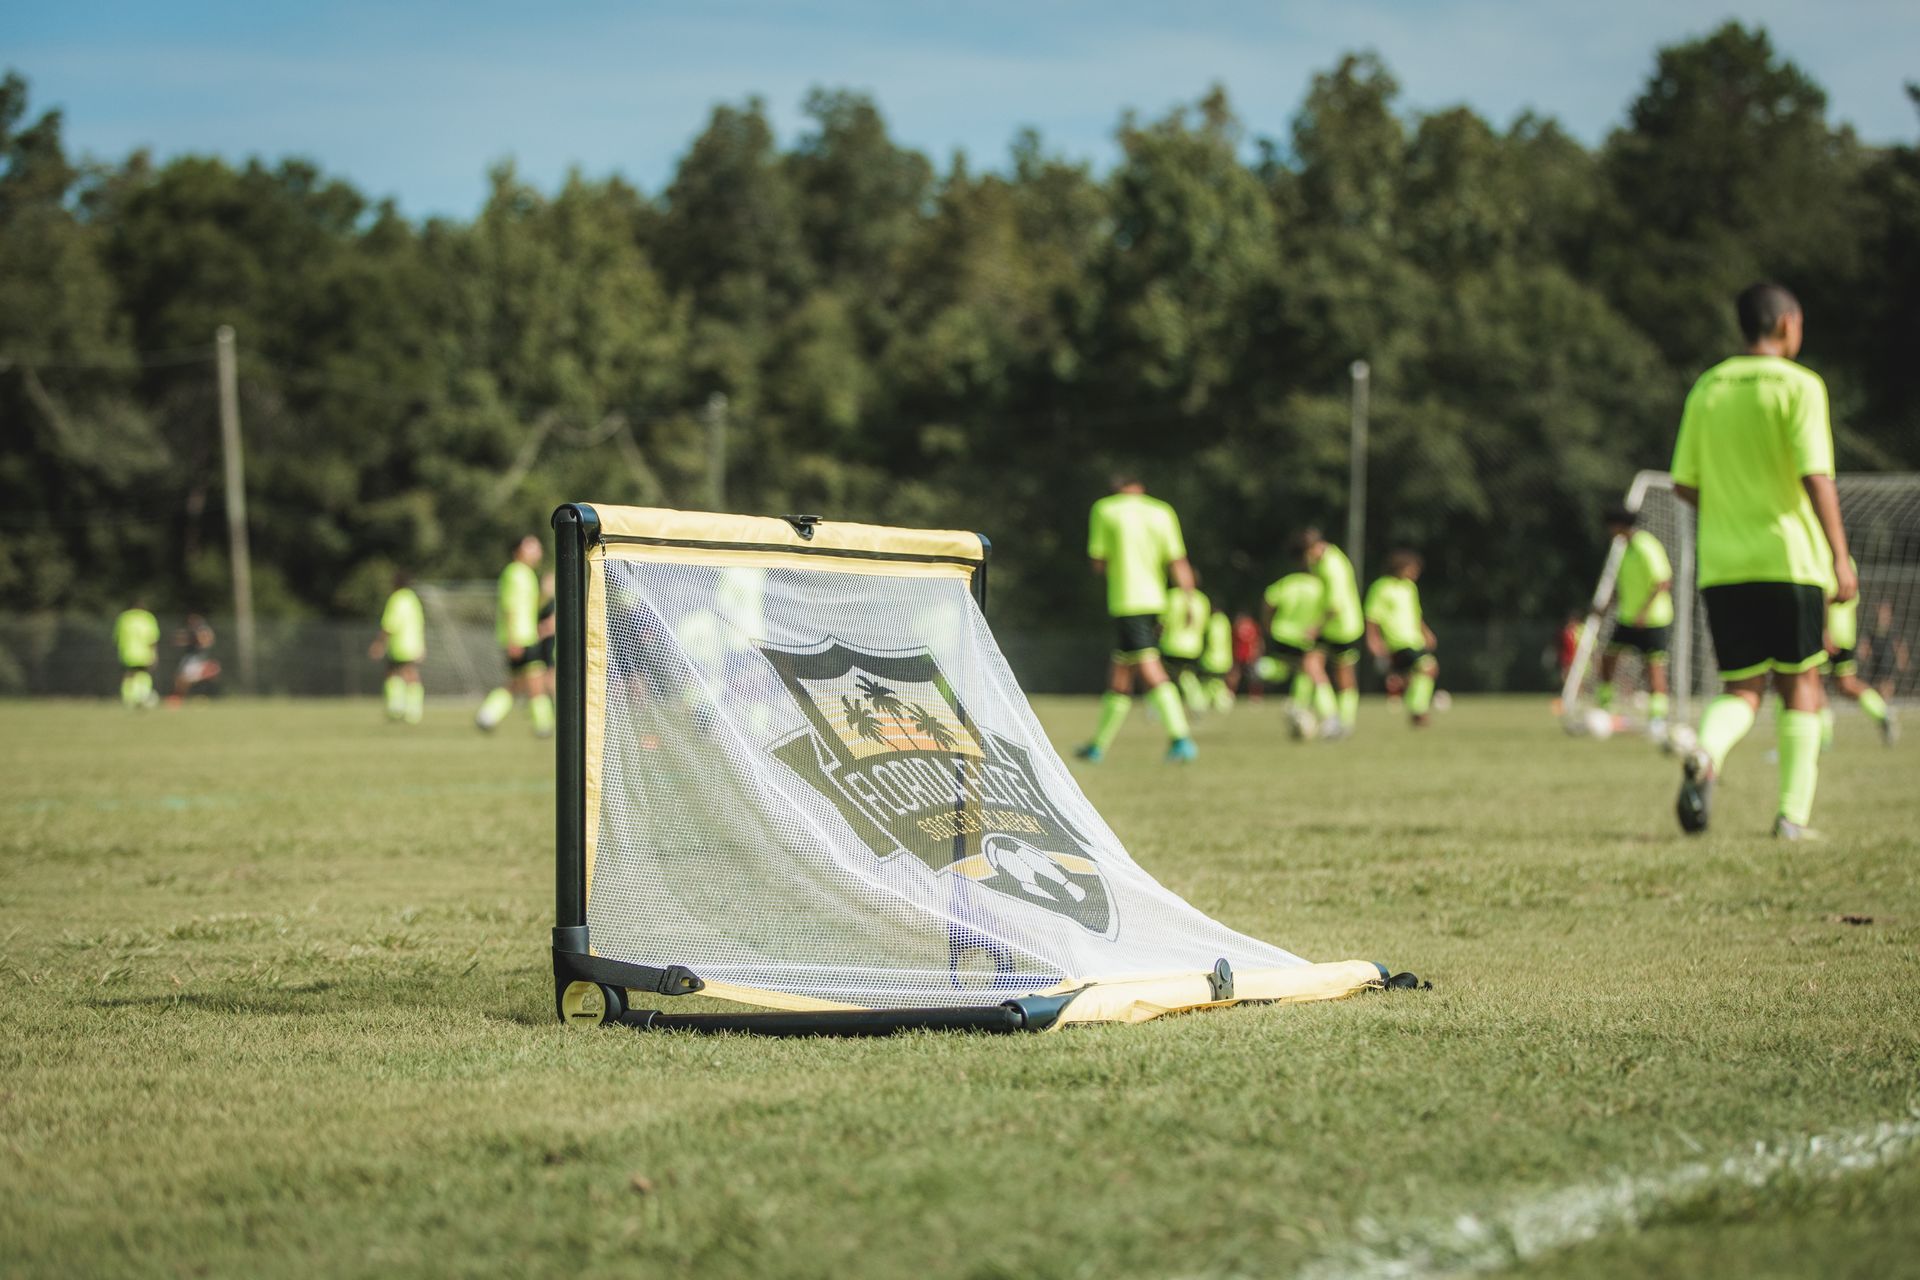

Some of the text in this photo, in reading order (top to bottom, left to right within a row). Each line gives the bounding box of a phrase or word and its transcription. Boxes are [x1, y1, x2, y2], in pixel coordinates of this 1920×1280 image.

[844, 757, 1047, 821] FLORIDA ELITE
[917, 810, 1048, 841] SOCCER ACADEMY
